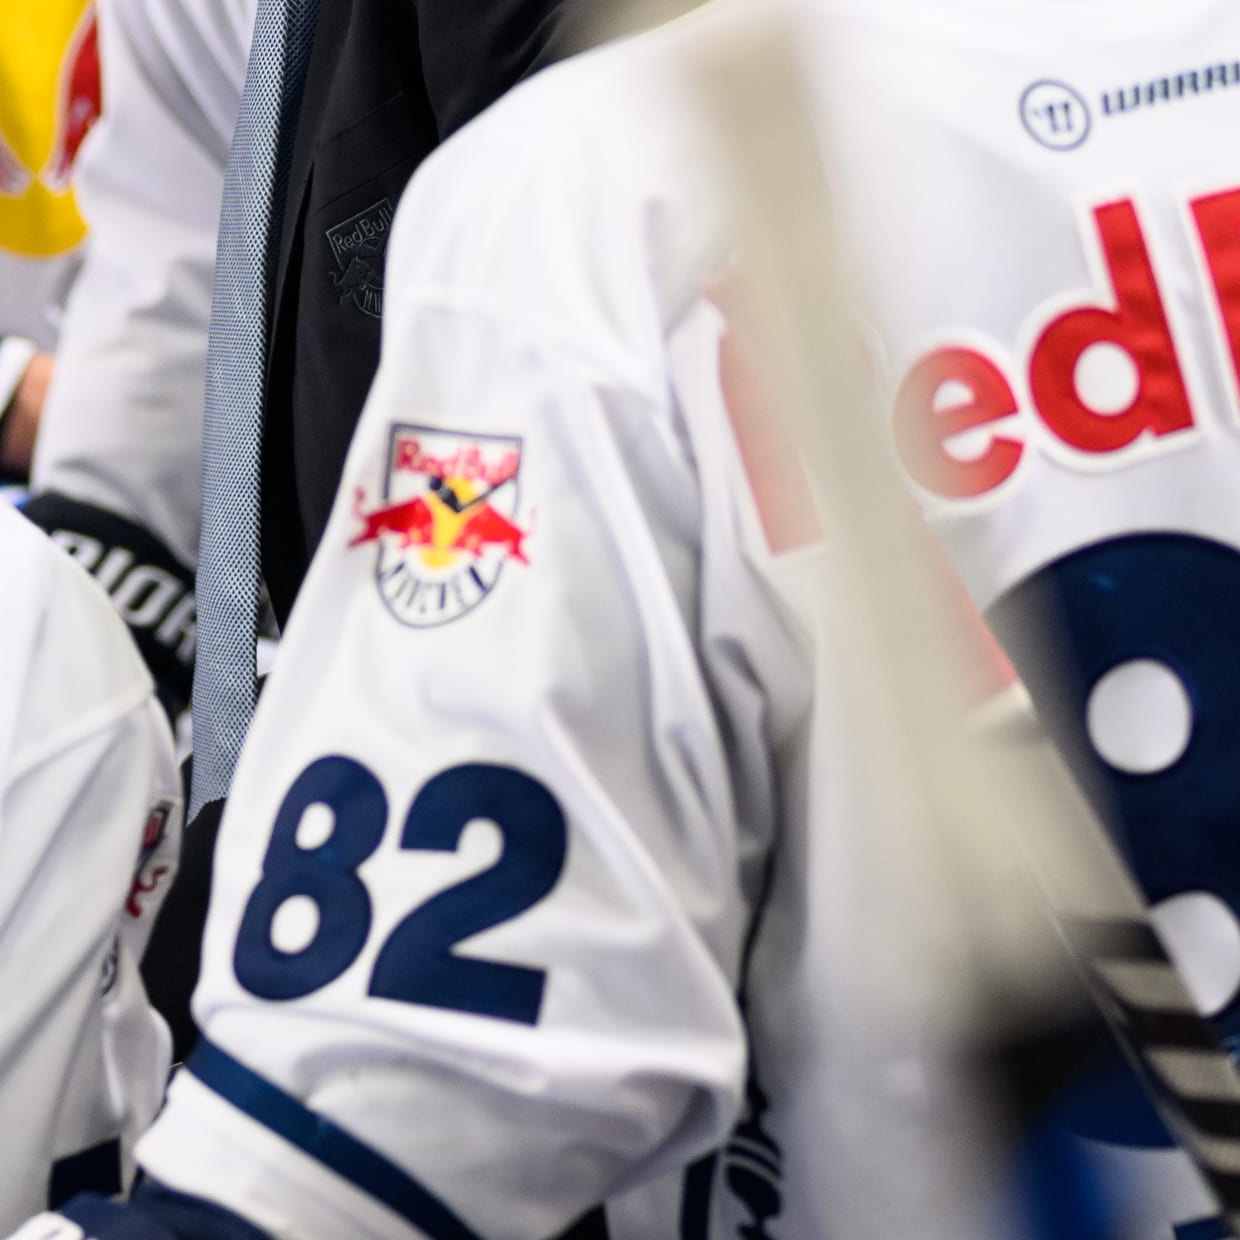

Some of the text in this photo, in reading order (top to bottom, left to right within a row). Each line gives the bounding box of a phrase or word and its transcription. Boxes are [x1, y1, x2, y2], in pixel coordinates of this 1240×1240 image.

[332, 206, 395, 255] Red Bull
[232, 753, 570, 1027] 82
